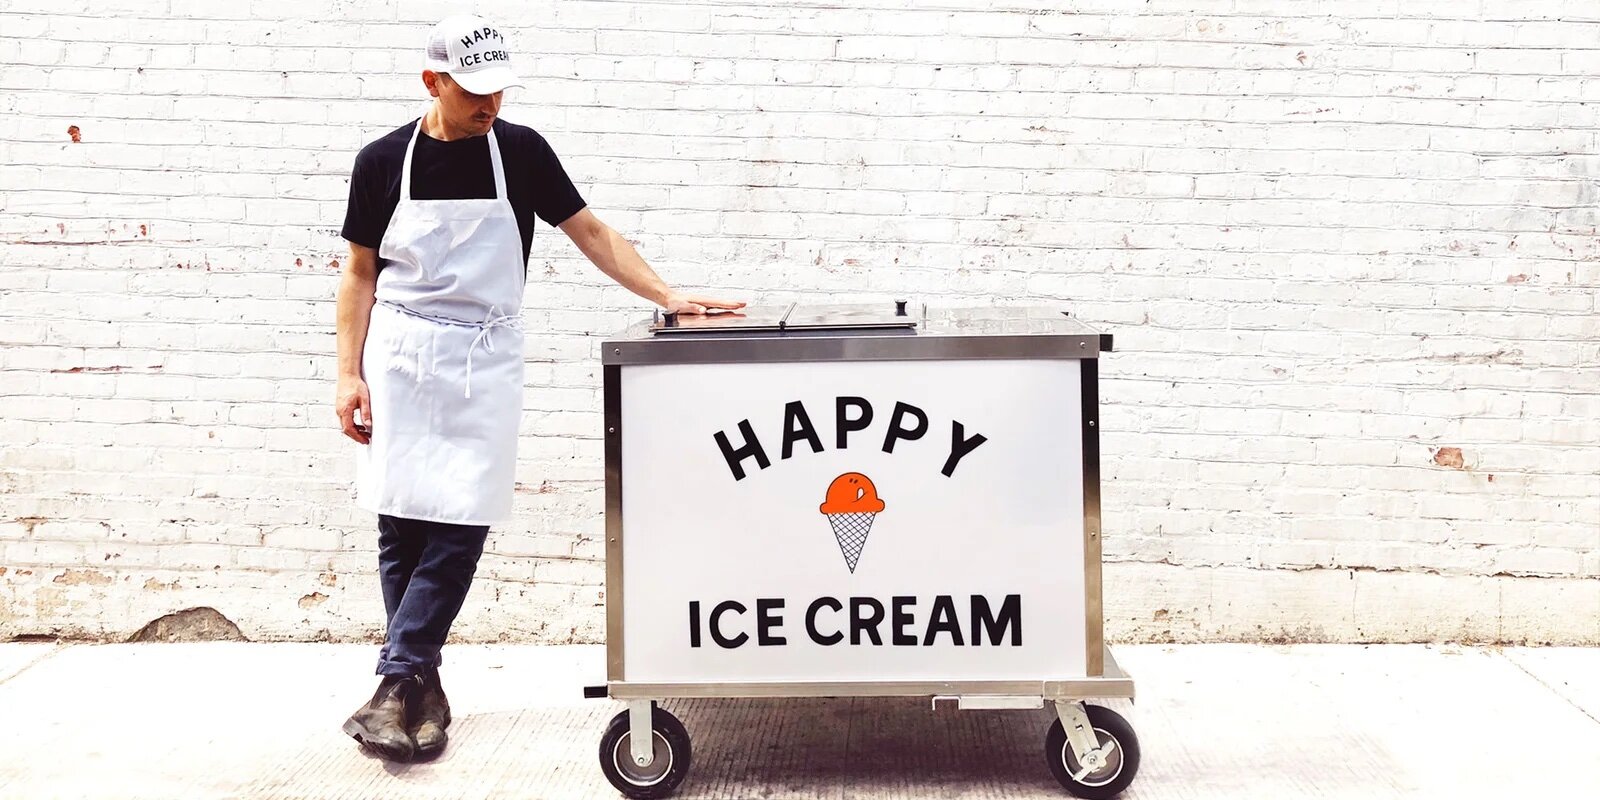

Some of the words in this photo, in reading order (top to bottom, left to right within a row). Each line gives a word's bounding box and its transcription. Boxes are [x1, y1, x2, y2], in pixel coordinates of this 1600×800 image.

[459, 53, 482, 67] ICE
[714, 396, 988, 481] HAPPY
[689, 598, 787, 650] ICE
[805, 594, 1023, 647] CREAM
